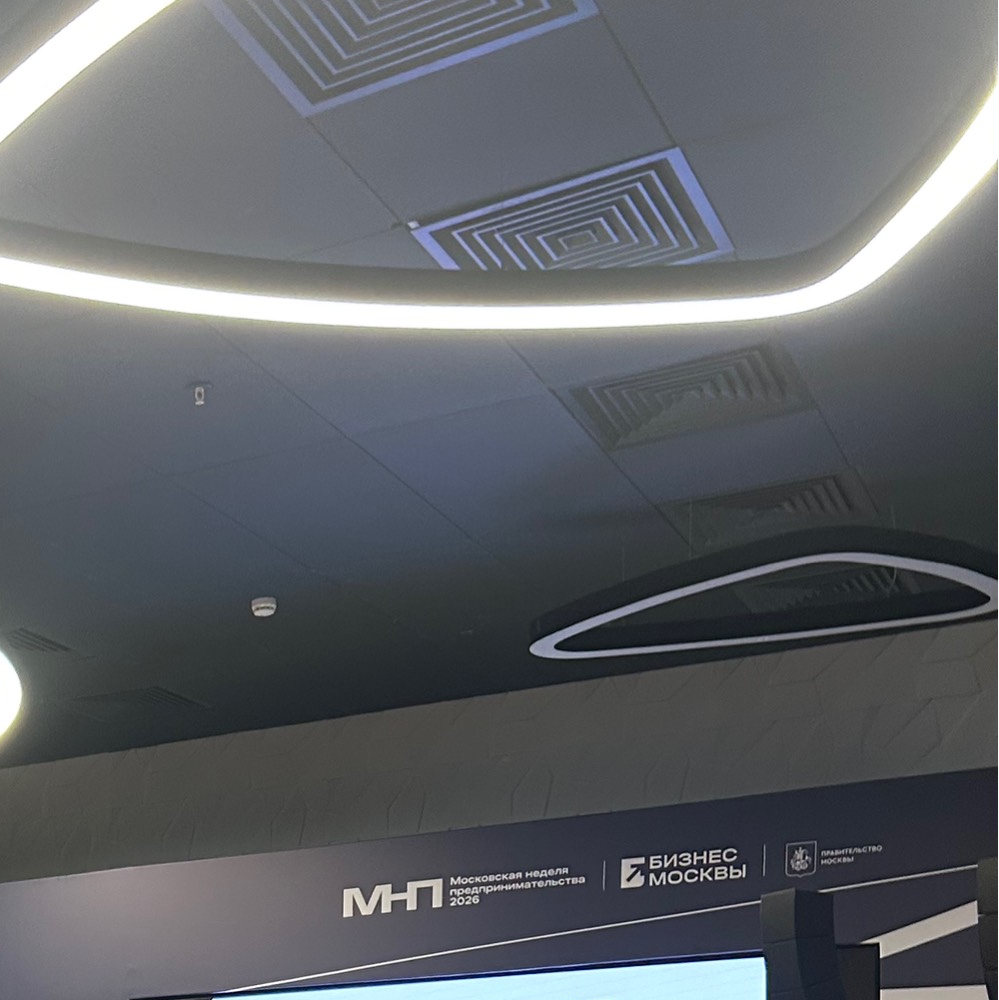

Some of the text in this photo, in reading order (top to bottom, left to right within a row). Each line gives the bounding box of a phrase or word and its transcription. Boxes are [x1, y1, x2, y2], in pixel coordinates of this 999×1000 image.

[649, 848, 738, 870] БИЗНЕС
[821, 845, 882, 857] ПРАВИТЕЛЬСТВО
[821, 856, 855, 865] МОСКВЫ
[450, 867, 569, 885] Московская неделя
[649, 864, 747, 887] МОСКВЫ
[449, 876, 586, 897] предпринимательства
[343, 878, 444, 918] МНП
[450, 896, 480, 906] 2026
